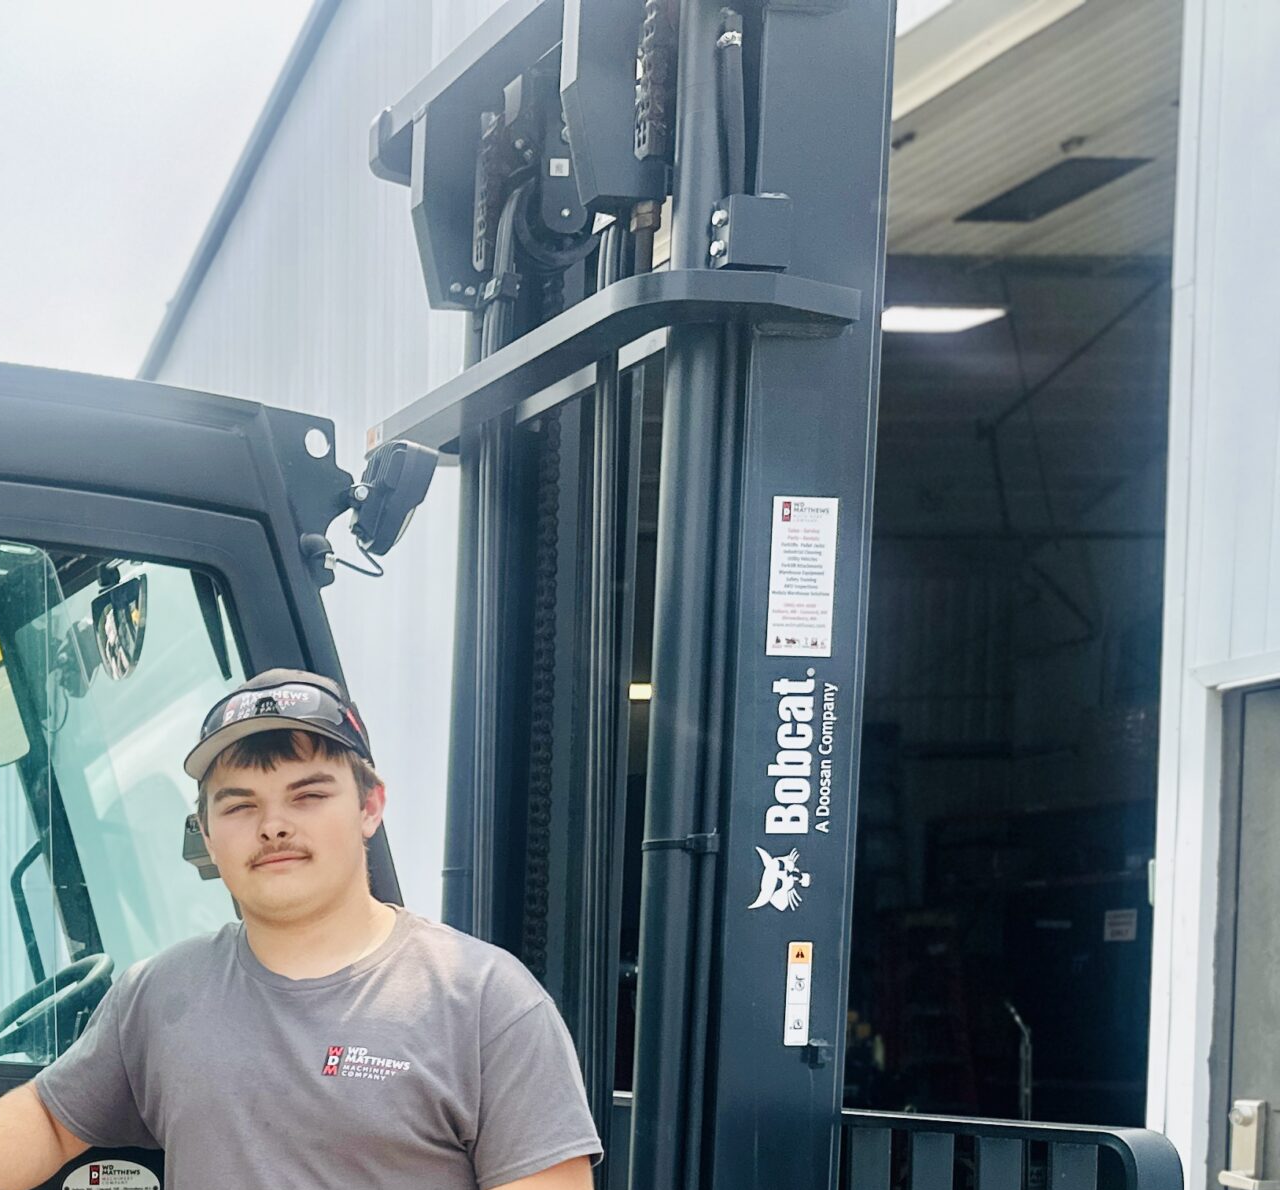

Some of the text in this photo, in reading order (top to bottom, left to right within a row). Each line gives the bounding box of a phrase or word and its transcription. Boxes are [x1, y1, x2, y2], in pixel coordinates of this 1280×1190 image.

[765, 677, 816, 833] Bobcat
[815, 682, 839, 833] A Doosan Company
[347, 1046, 368, 1056] WD
[344, 1054, 411, 1071] MATTHEWS
[341, 1071, 386, 1081] COMPANY
[342, 1064, 397, 1077] MACHINERY
